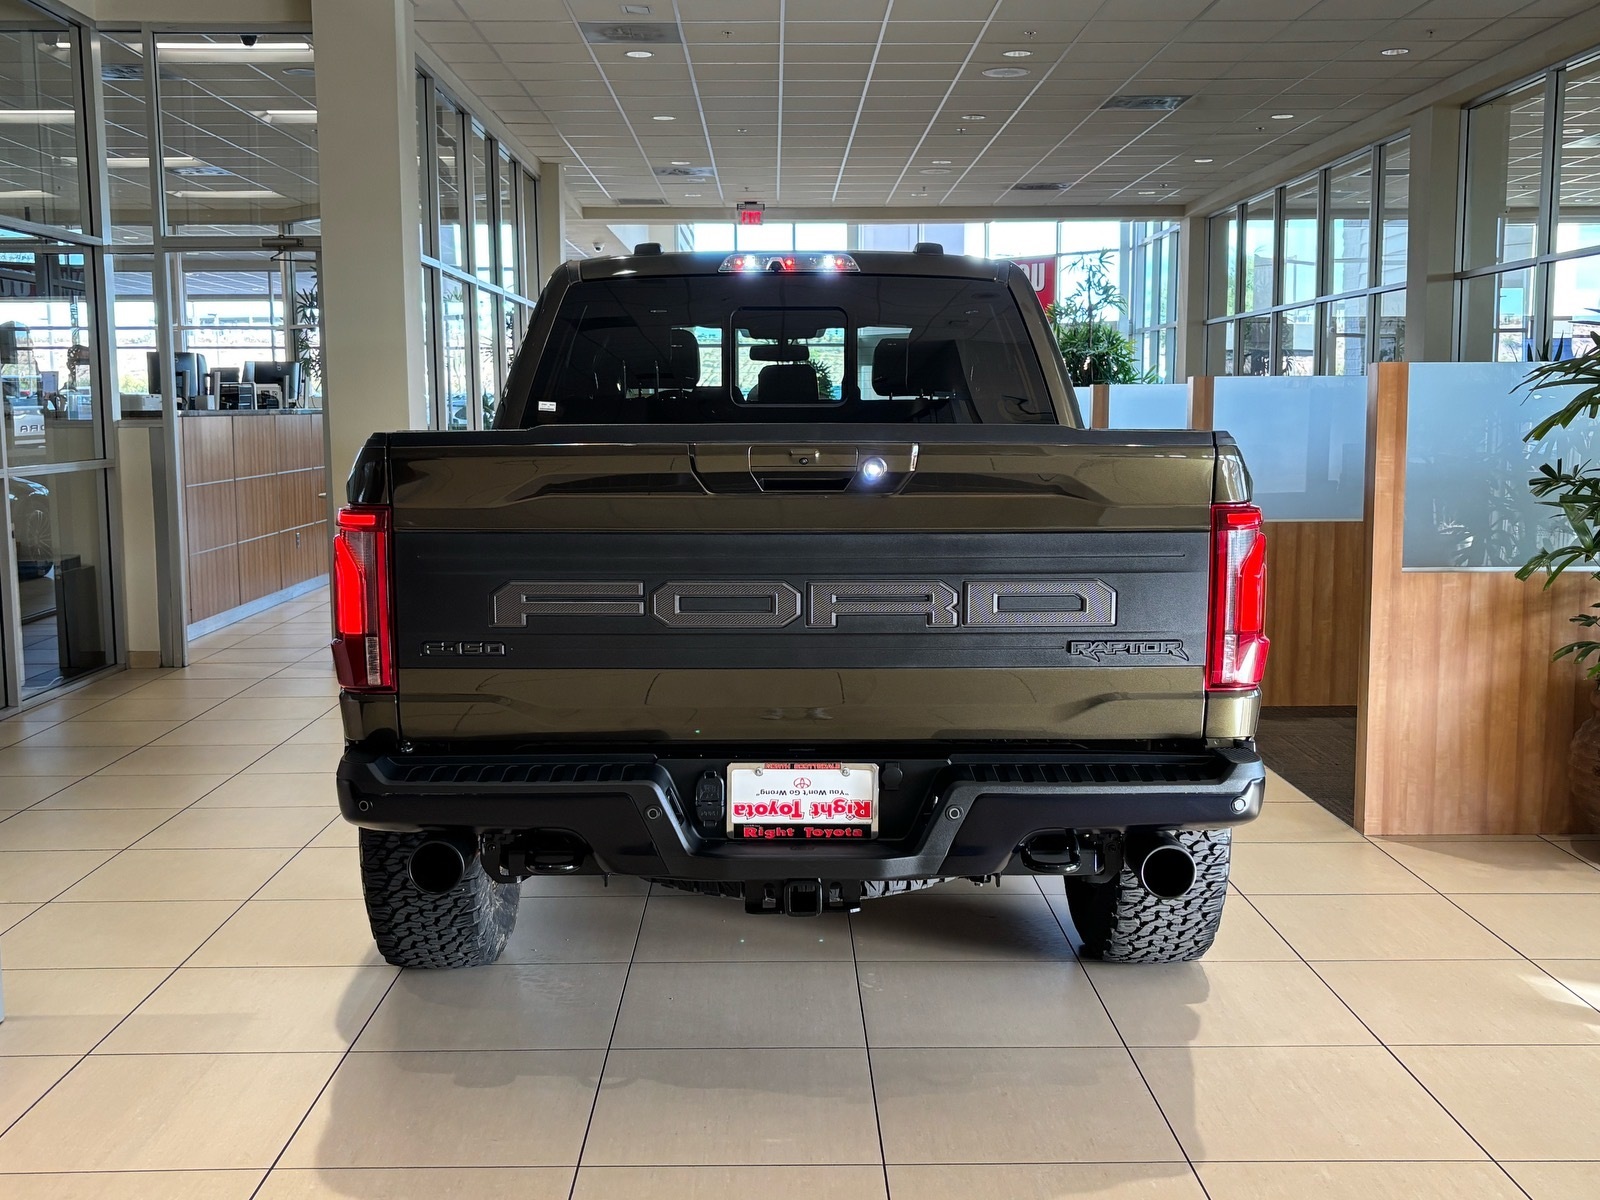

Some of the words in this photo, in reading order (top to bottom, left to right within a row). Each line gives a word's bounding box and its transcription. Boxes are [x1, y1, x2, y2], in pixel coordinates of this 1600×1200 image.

[489, 579, 1117, 628] FORD
[421, 640, 506, 656] F-150
[1067, 640, 1189, 661] RAPTOR
[733, 799, 804, 820] Toyota
[810, 797, 872, 820] Right
[743, 826, 795, 839] Right
[803, 826, 863, 838] Toyota
